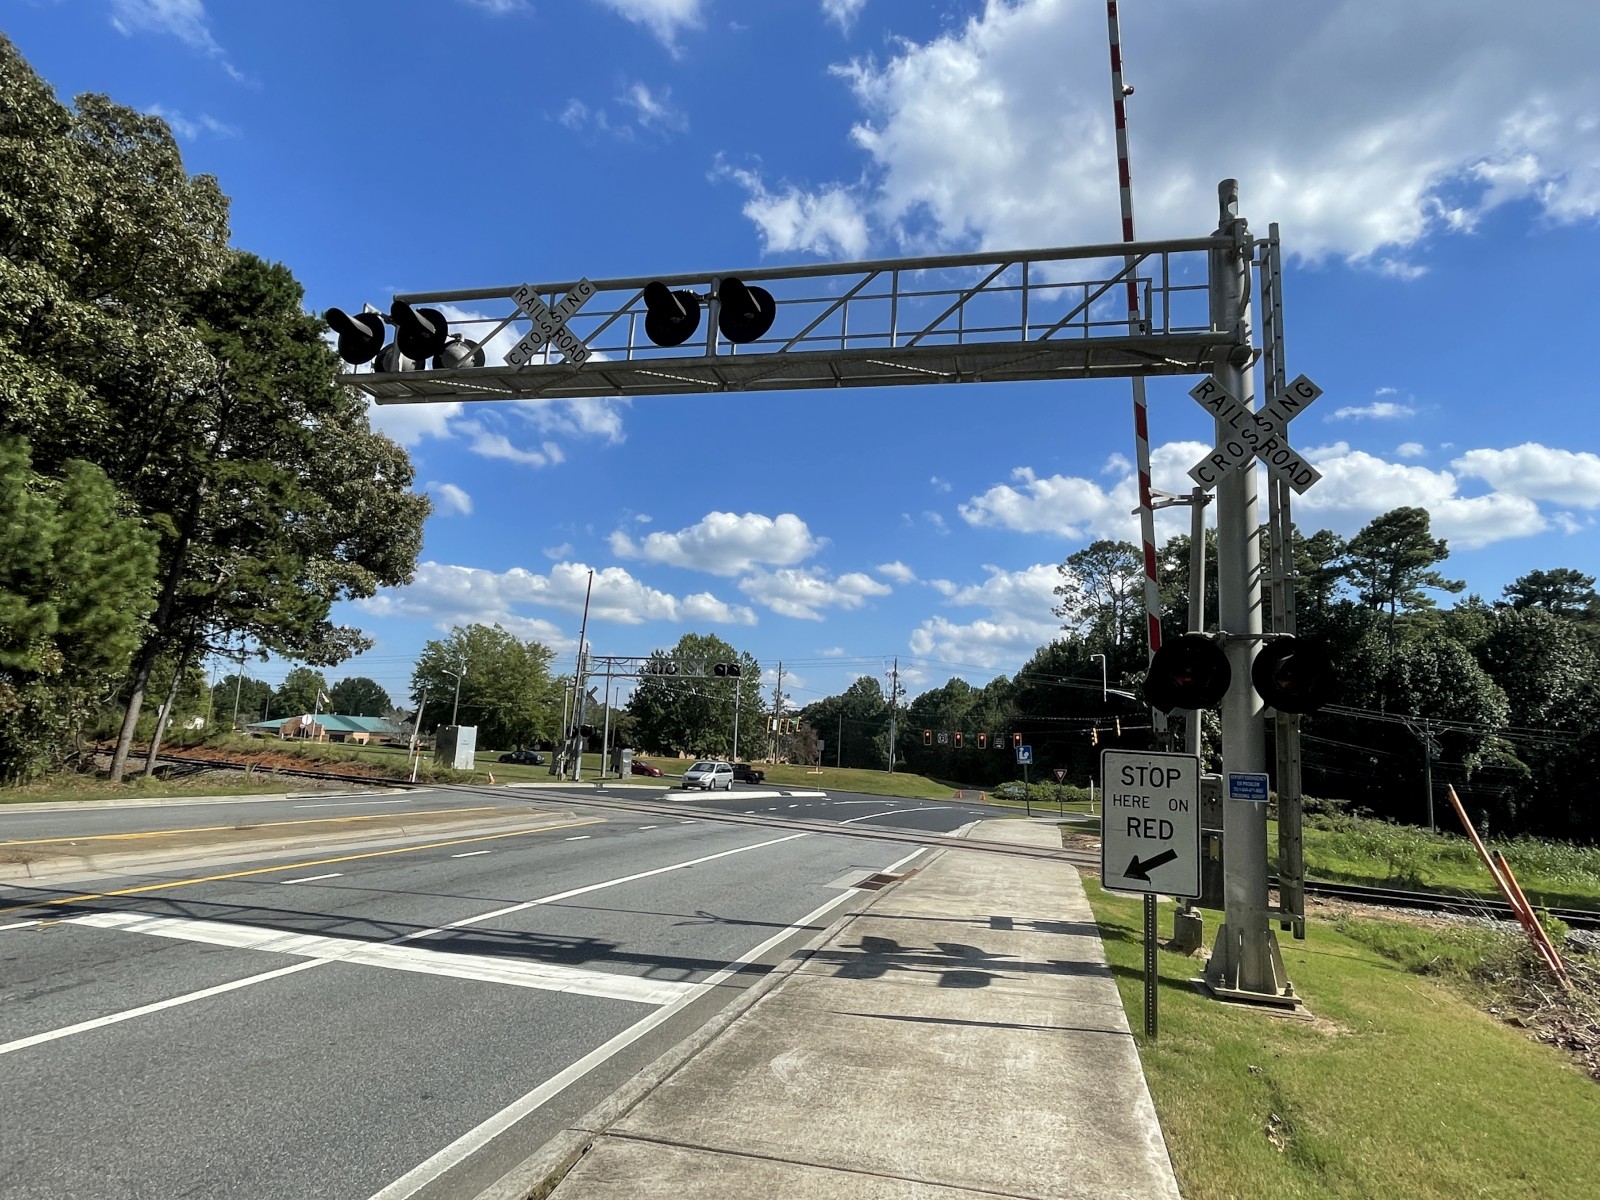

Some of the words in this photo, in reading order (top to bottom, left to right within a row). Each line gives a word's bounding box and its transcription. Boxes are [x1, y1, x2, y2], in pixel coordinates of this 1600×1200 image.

[509, 283, 590, 365] CROSSING
[1197, 382, 1314, 483] CROSSING
[1120, 765, 1181, 789] STOP
[1112, 793, 1150, 809] HERE
[1168, 798, 1189, 812] ON
[1127, 816, 1174, 841] RED
